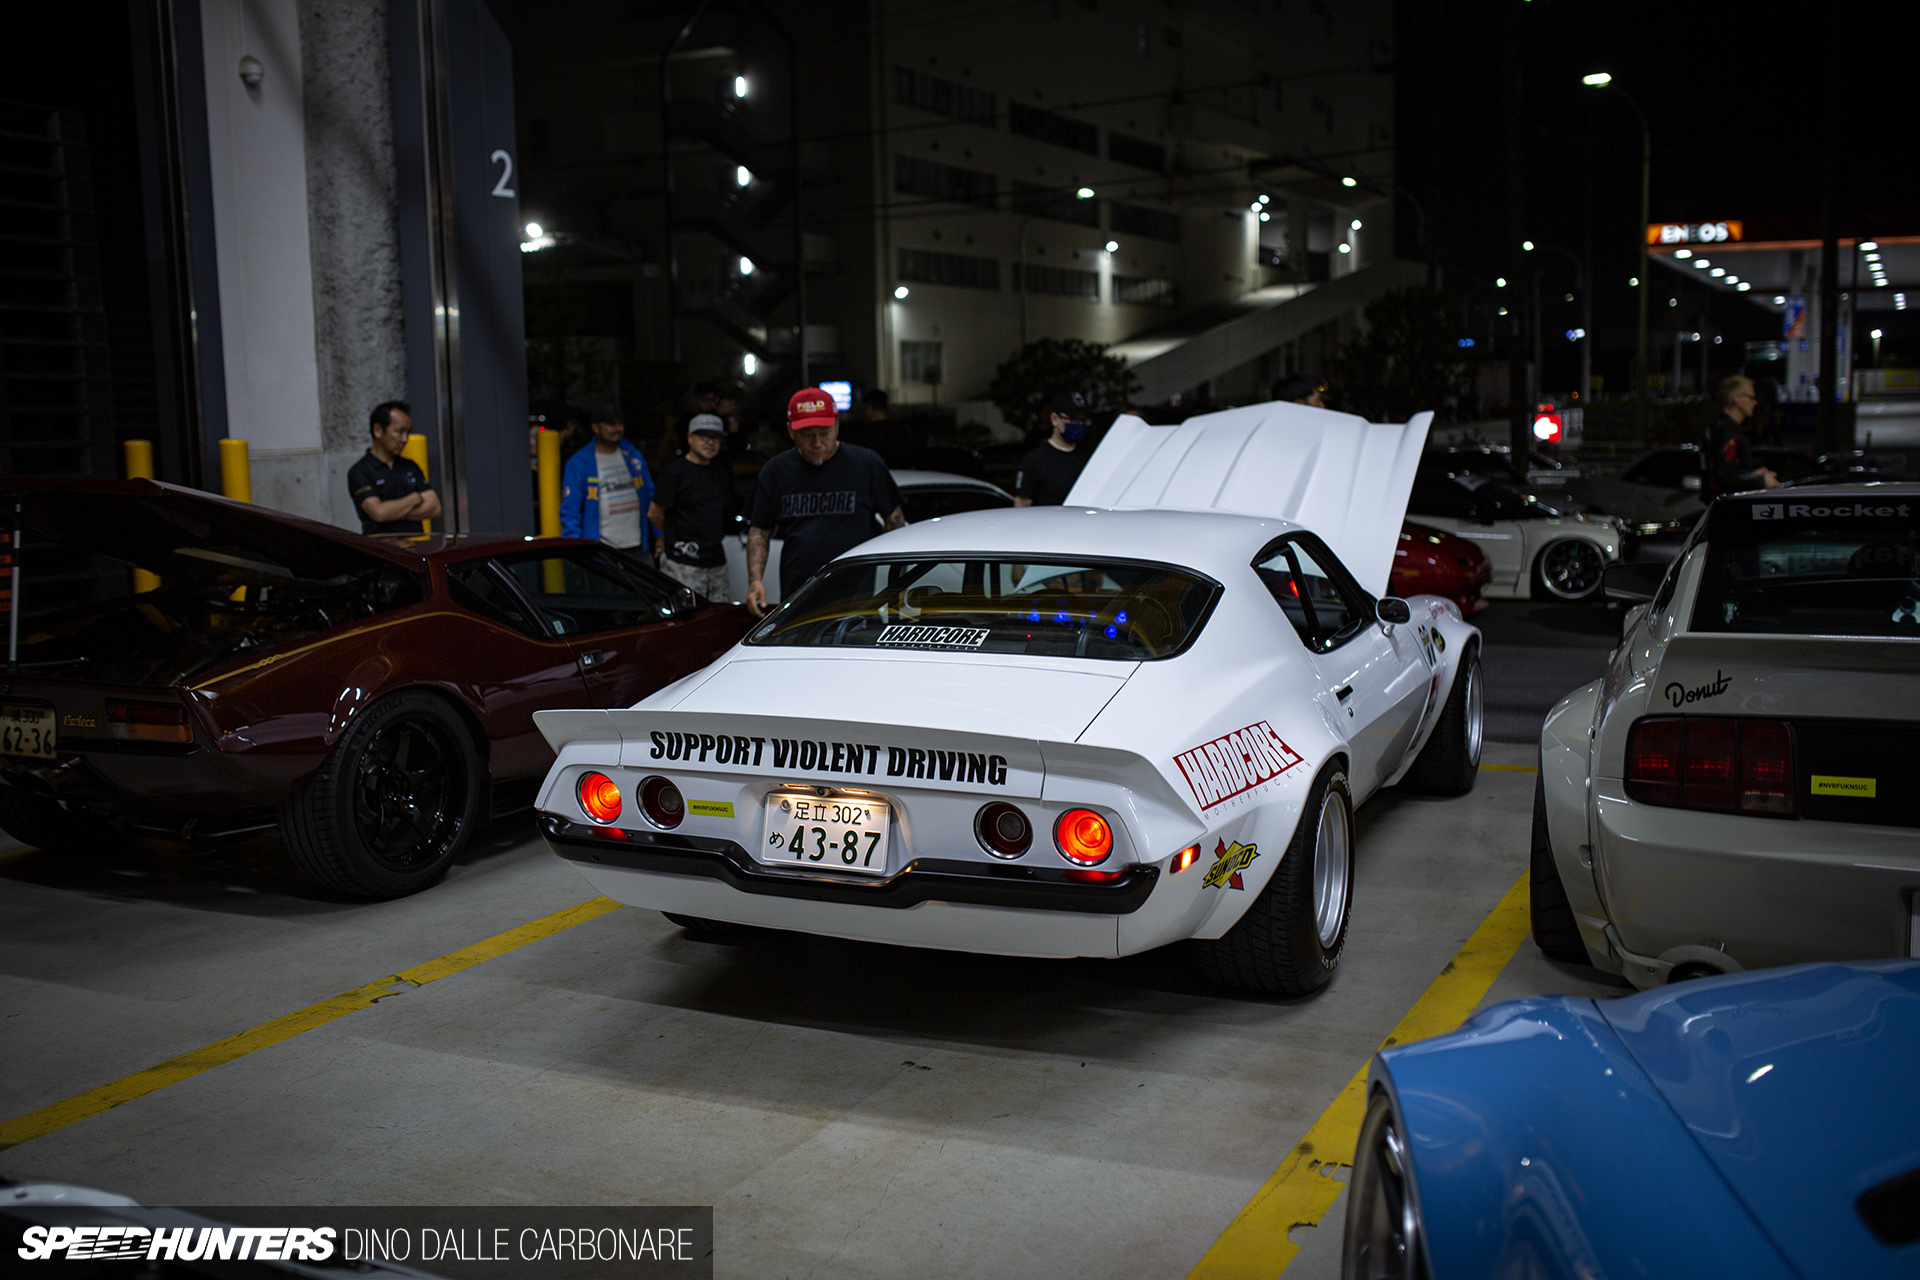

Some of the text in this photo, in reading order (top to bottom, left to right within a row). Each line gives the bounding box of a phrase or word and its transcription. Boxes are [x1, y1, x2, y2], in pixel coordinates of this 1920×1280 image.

[491, 149, 516, 199] 2
[1661, 222, 1729, 243] ENEOS
[797, 400, 825, 411] FIELD
[782, 492, 855, 516] HARDCORE
[1789, 503, 1911, 518] Rocket
[879, 625, 988, 646] HARDCORE
[1665, 670, 1732, 708] Donut
[650, 731, 1008, 785] SUPPORT VIOLENT DRIVING
[1177, 721, 1300, 809] HARDCORE
[1203, 761, 1313, 821] MOTHERFUCKER
[794, 802, 862, 825] 足立 302
[769, 825, 881, 867] め 43-87
[1205, 847, 1255, 885] SUNOCO
